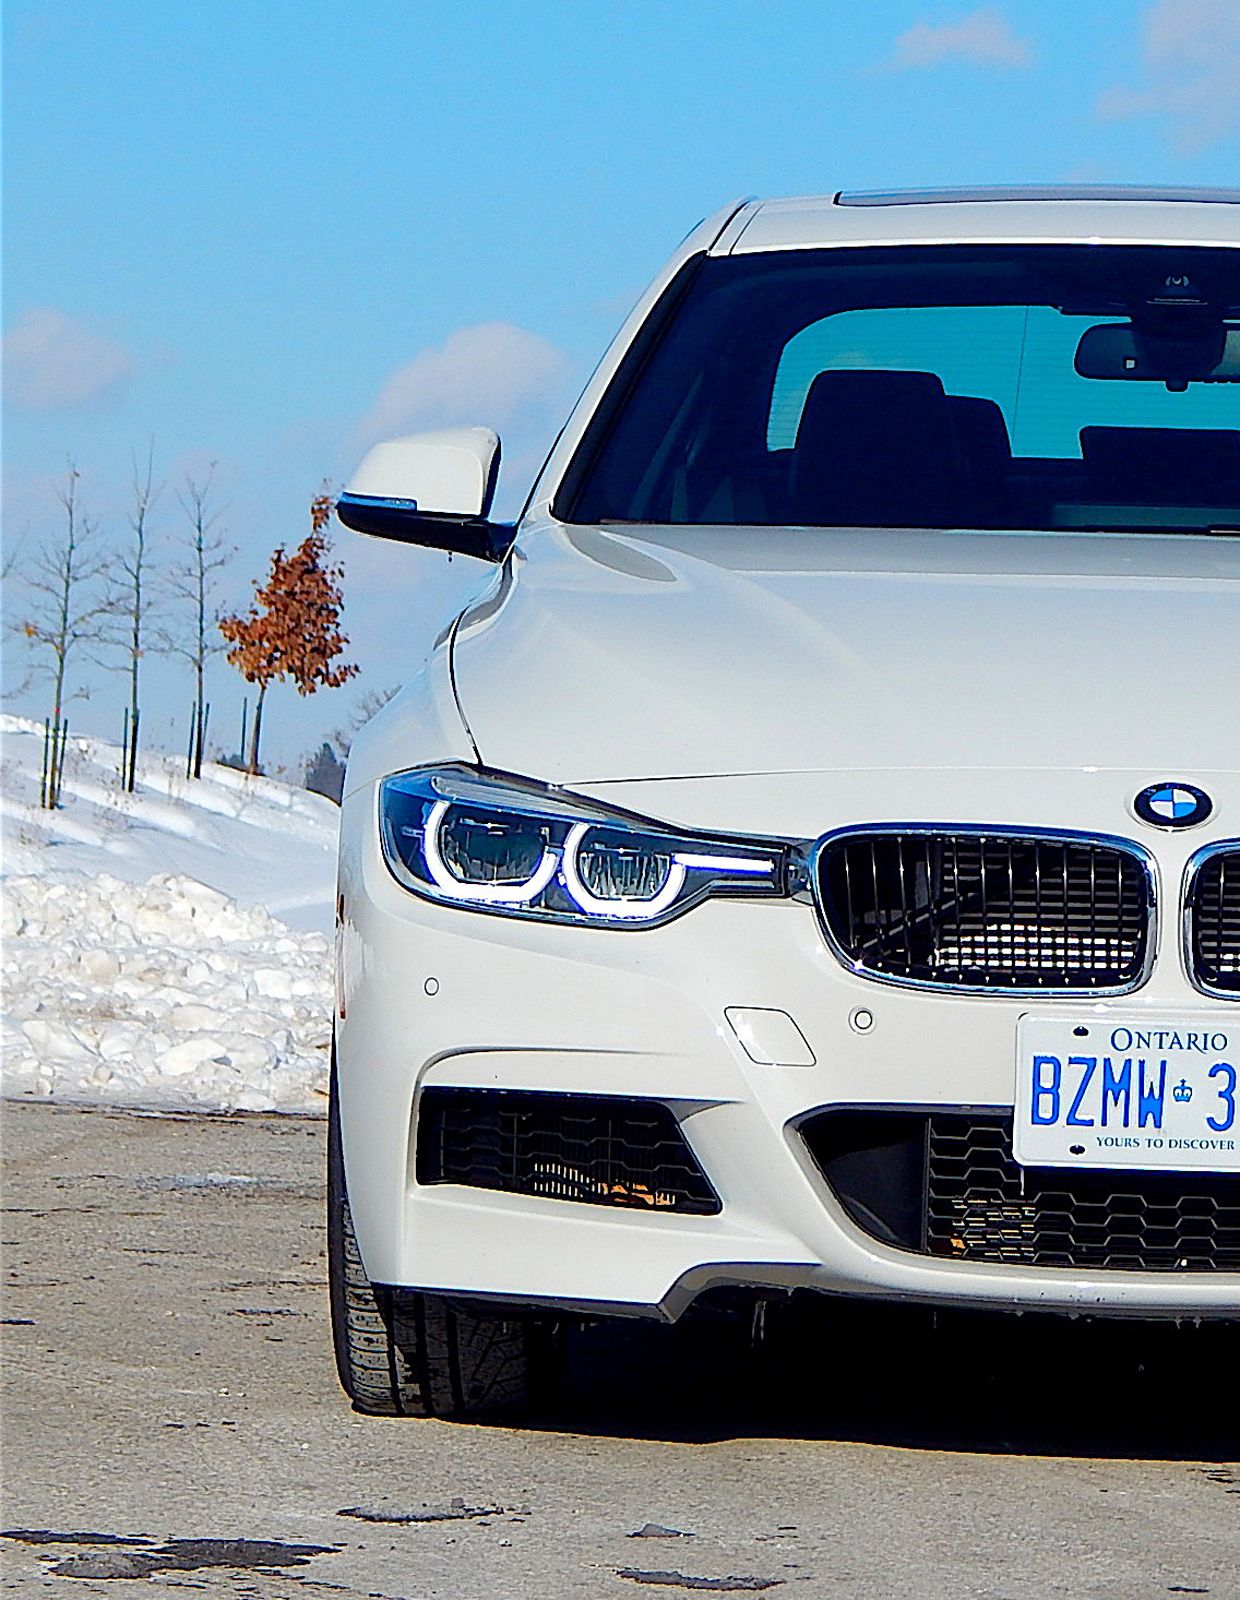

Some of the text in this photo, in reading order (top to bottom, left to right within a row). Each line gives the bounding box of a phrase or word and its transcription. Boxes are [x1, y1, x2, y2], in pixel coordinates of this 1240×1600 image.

[1110, 1027, 1228, 1054] ONTARIO
[1031, 1055, 1168, 1130] BZMW
[1096, 1136, 1236, 1151] YOURS TO DISCOVER
